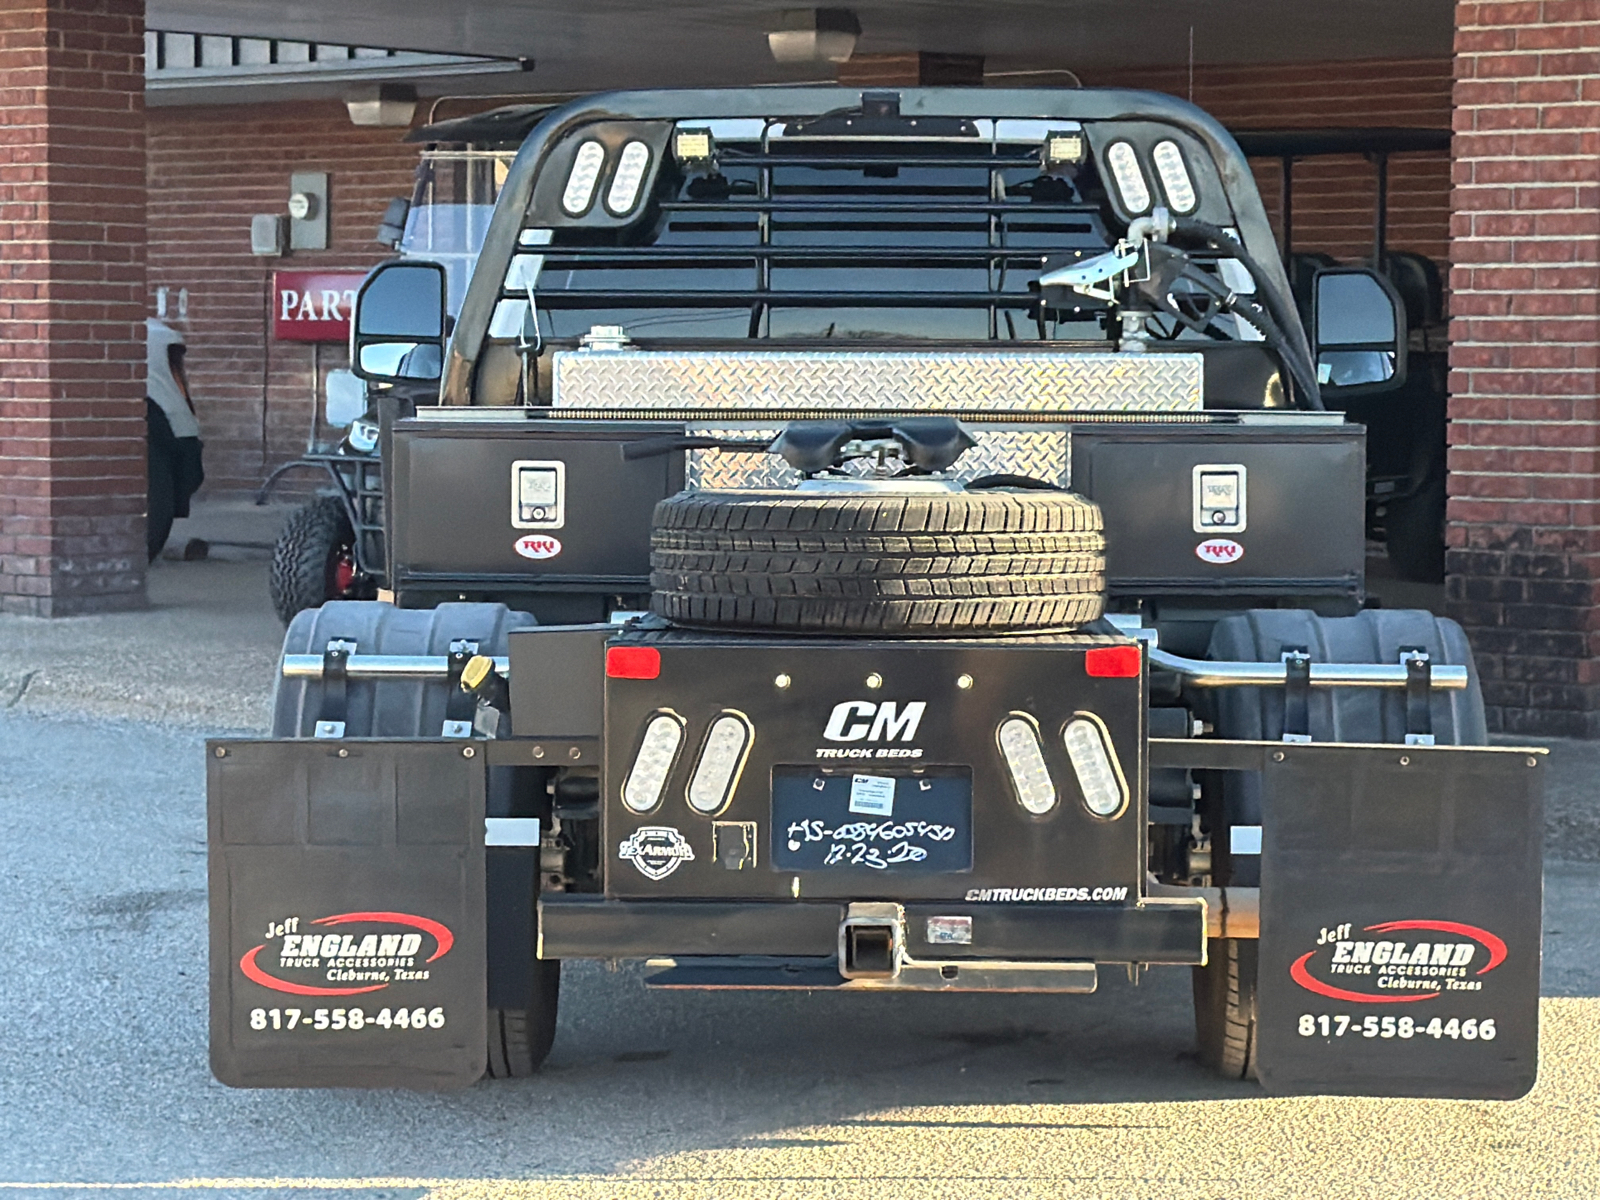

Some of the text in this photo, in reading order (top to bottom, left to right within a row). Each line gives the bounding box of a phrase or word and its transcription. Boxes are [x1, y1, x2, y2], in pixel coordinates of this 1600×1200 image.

[823, 700, 927, 741] CM
[815, 748, 923, 758] TRUCK BEDS
[965, 887, 1128, 902] CMTRUCKBEDS.COM
[265, 917, 299, 938] Jeff
[1317, 923, 1352, 945] Jeff
[280, 934, 422, 957] ENGLAND
[1332, 941, 1475, 966] ENGLAND
[279, 958, 414, 967] TRUCK ACCESSORIES
[1331, 964, 1466, 976] TRUCK ACCESSORIES
[394, 969, 430, 980] Texas
[1377, 976, 1482, 991] Cleburne, Texas
[250, 1007, 445, 1030] 817-558-4466
[1298, 1014, 1496, 1040] 817-558-4466
